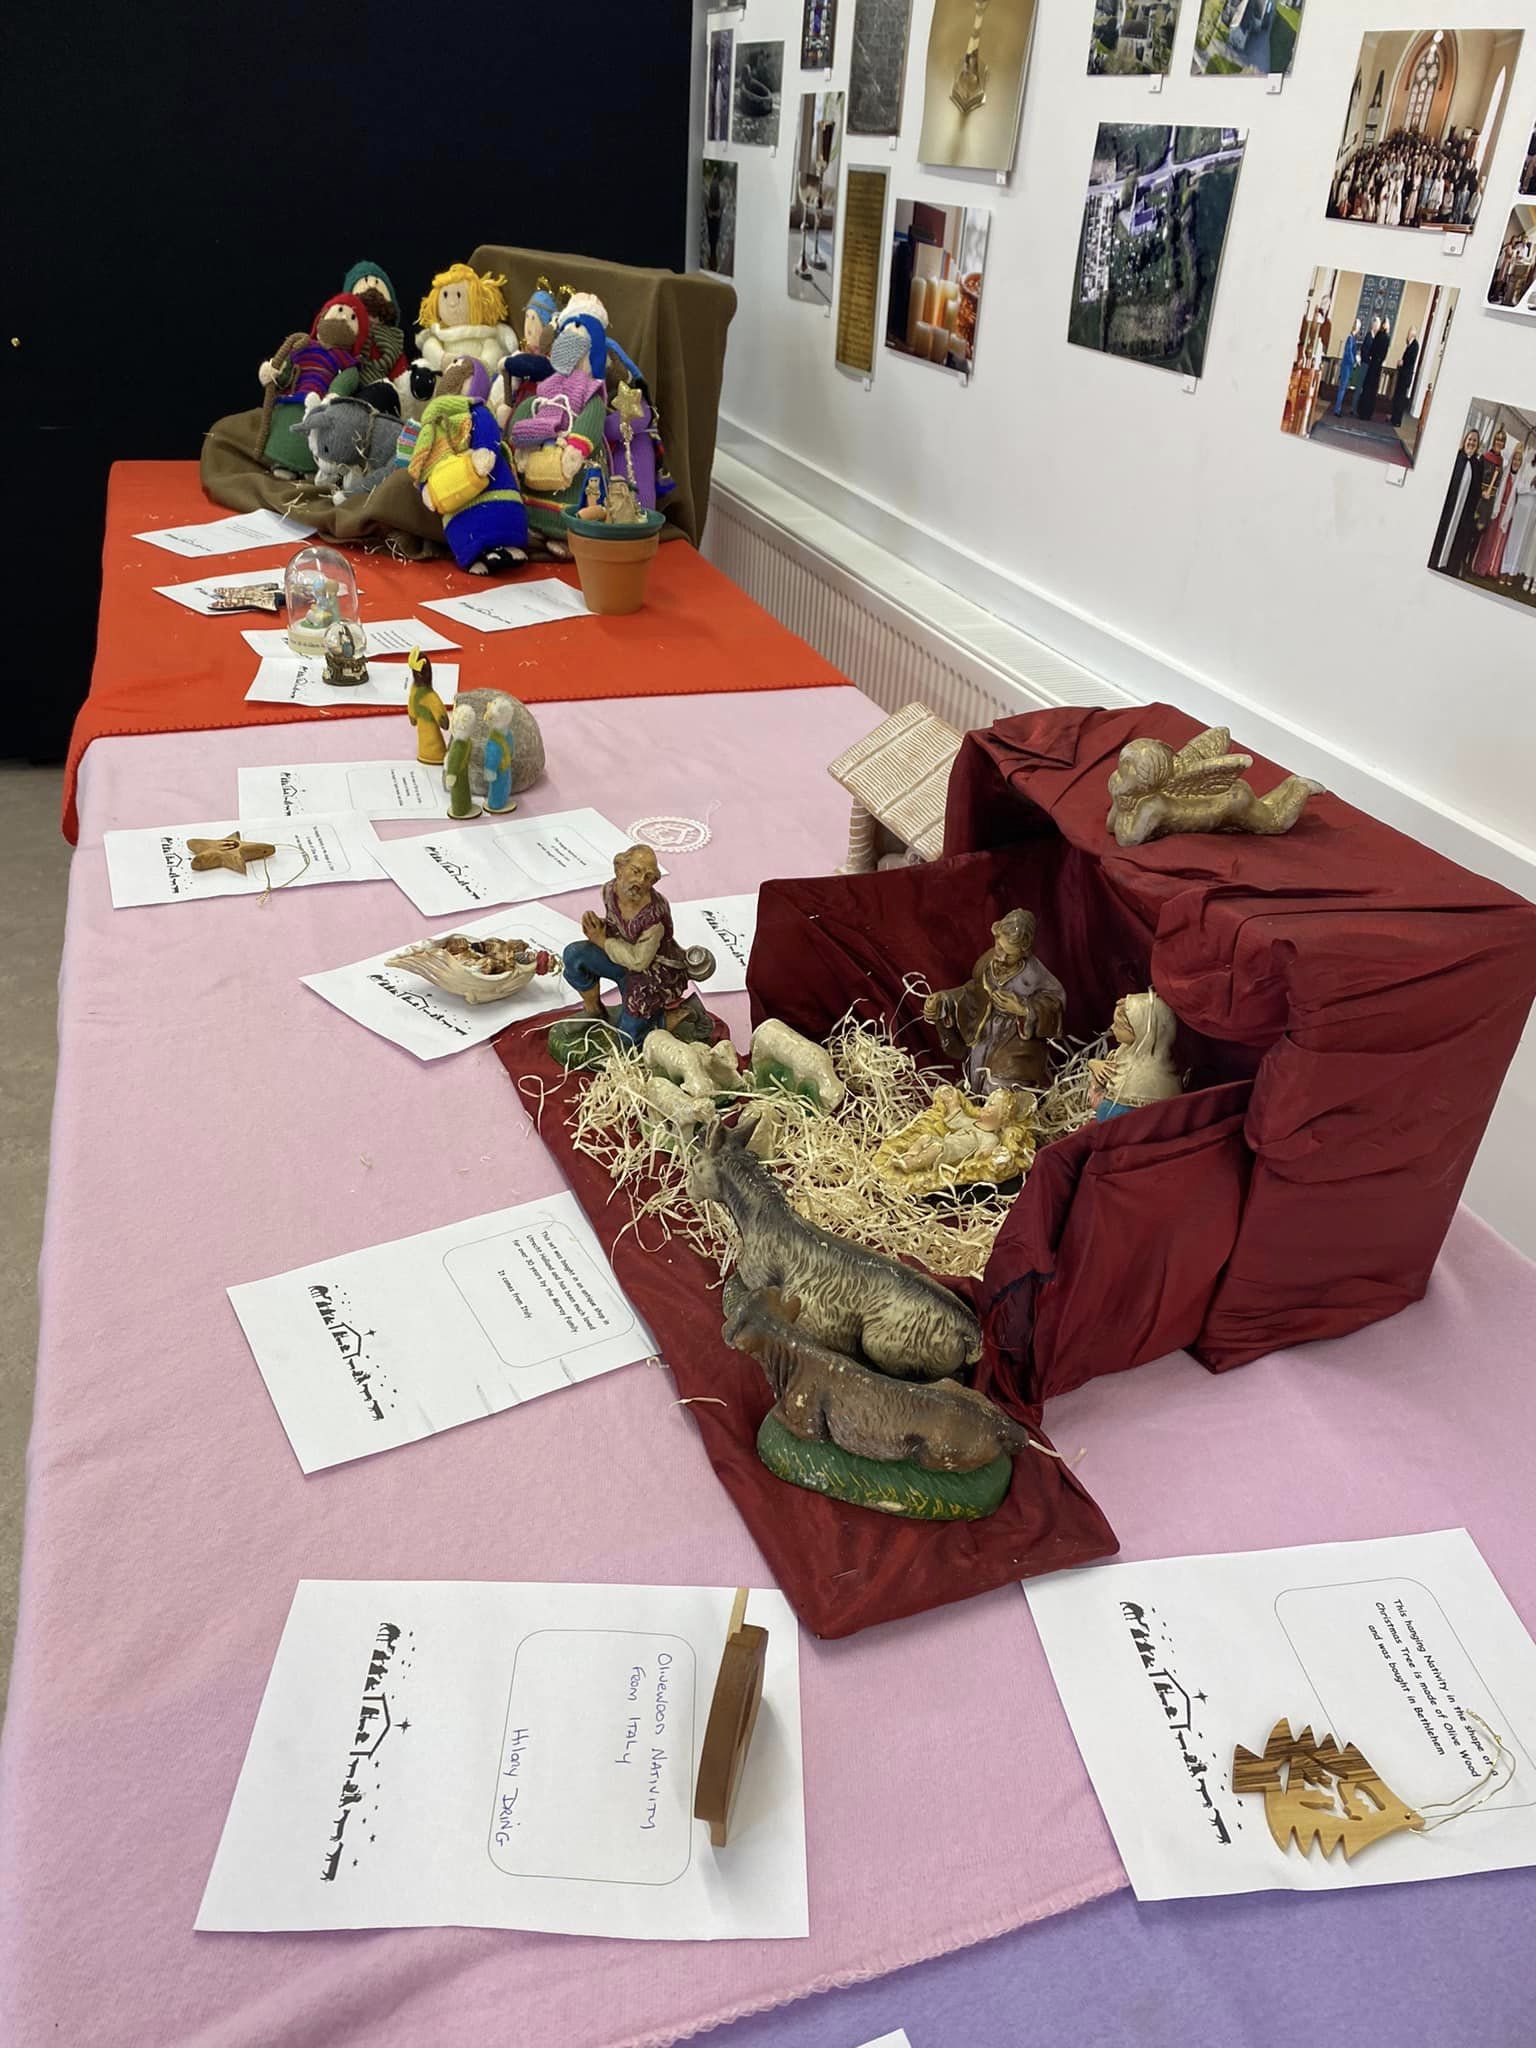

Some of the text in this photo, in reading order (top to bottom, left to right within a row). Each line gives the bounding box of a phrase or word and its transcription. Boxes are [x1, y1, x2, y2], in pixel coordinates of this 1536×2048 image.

[502, 1277, 515, 1292] comes
[512, 1292, 524, 1306] from
[529, 1266, 543, 1280] years
[546, 1288, 554, 1297] the
[552, 1271, 562, 1281] and
[564, 1290, 576, 1303] been
[574, 1303, 586, 1316] much
[583, 1316, 597, 1330] loved
[561, 1259, 575, 1276] bought
[581, 1289, 597, 1307] antique
[1368, 1624, 1446, 1756] and was bought in Bethlehem
[1375, 1601, 1482, 1777] Christmas Tree is made of Olive Wood
[1393, 1598, 1407, 1618] This
[1404, 1619, 1427, 1653] hanging
[1424, 1654, 1449, 1692] Nativity
[1446, 1694, 1456, 1703] in
[1453, 1705, 1466, 1722] the
[1464, 1724, 1485, 1752] shape
[1482, 1755, 1493, 1765] of
